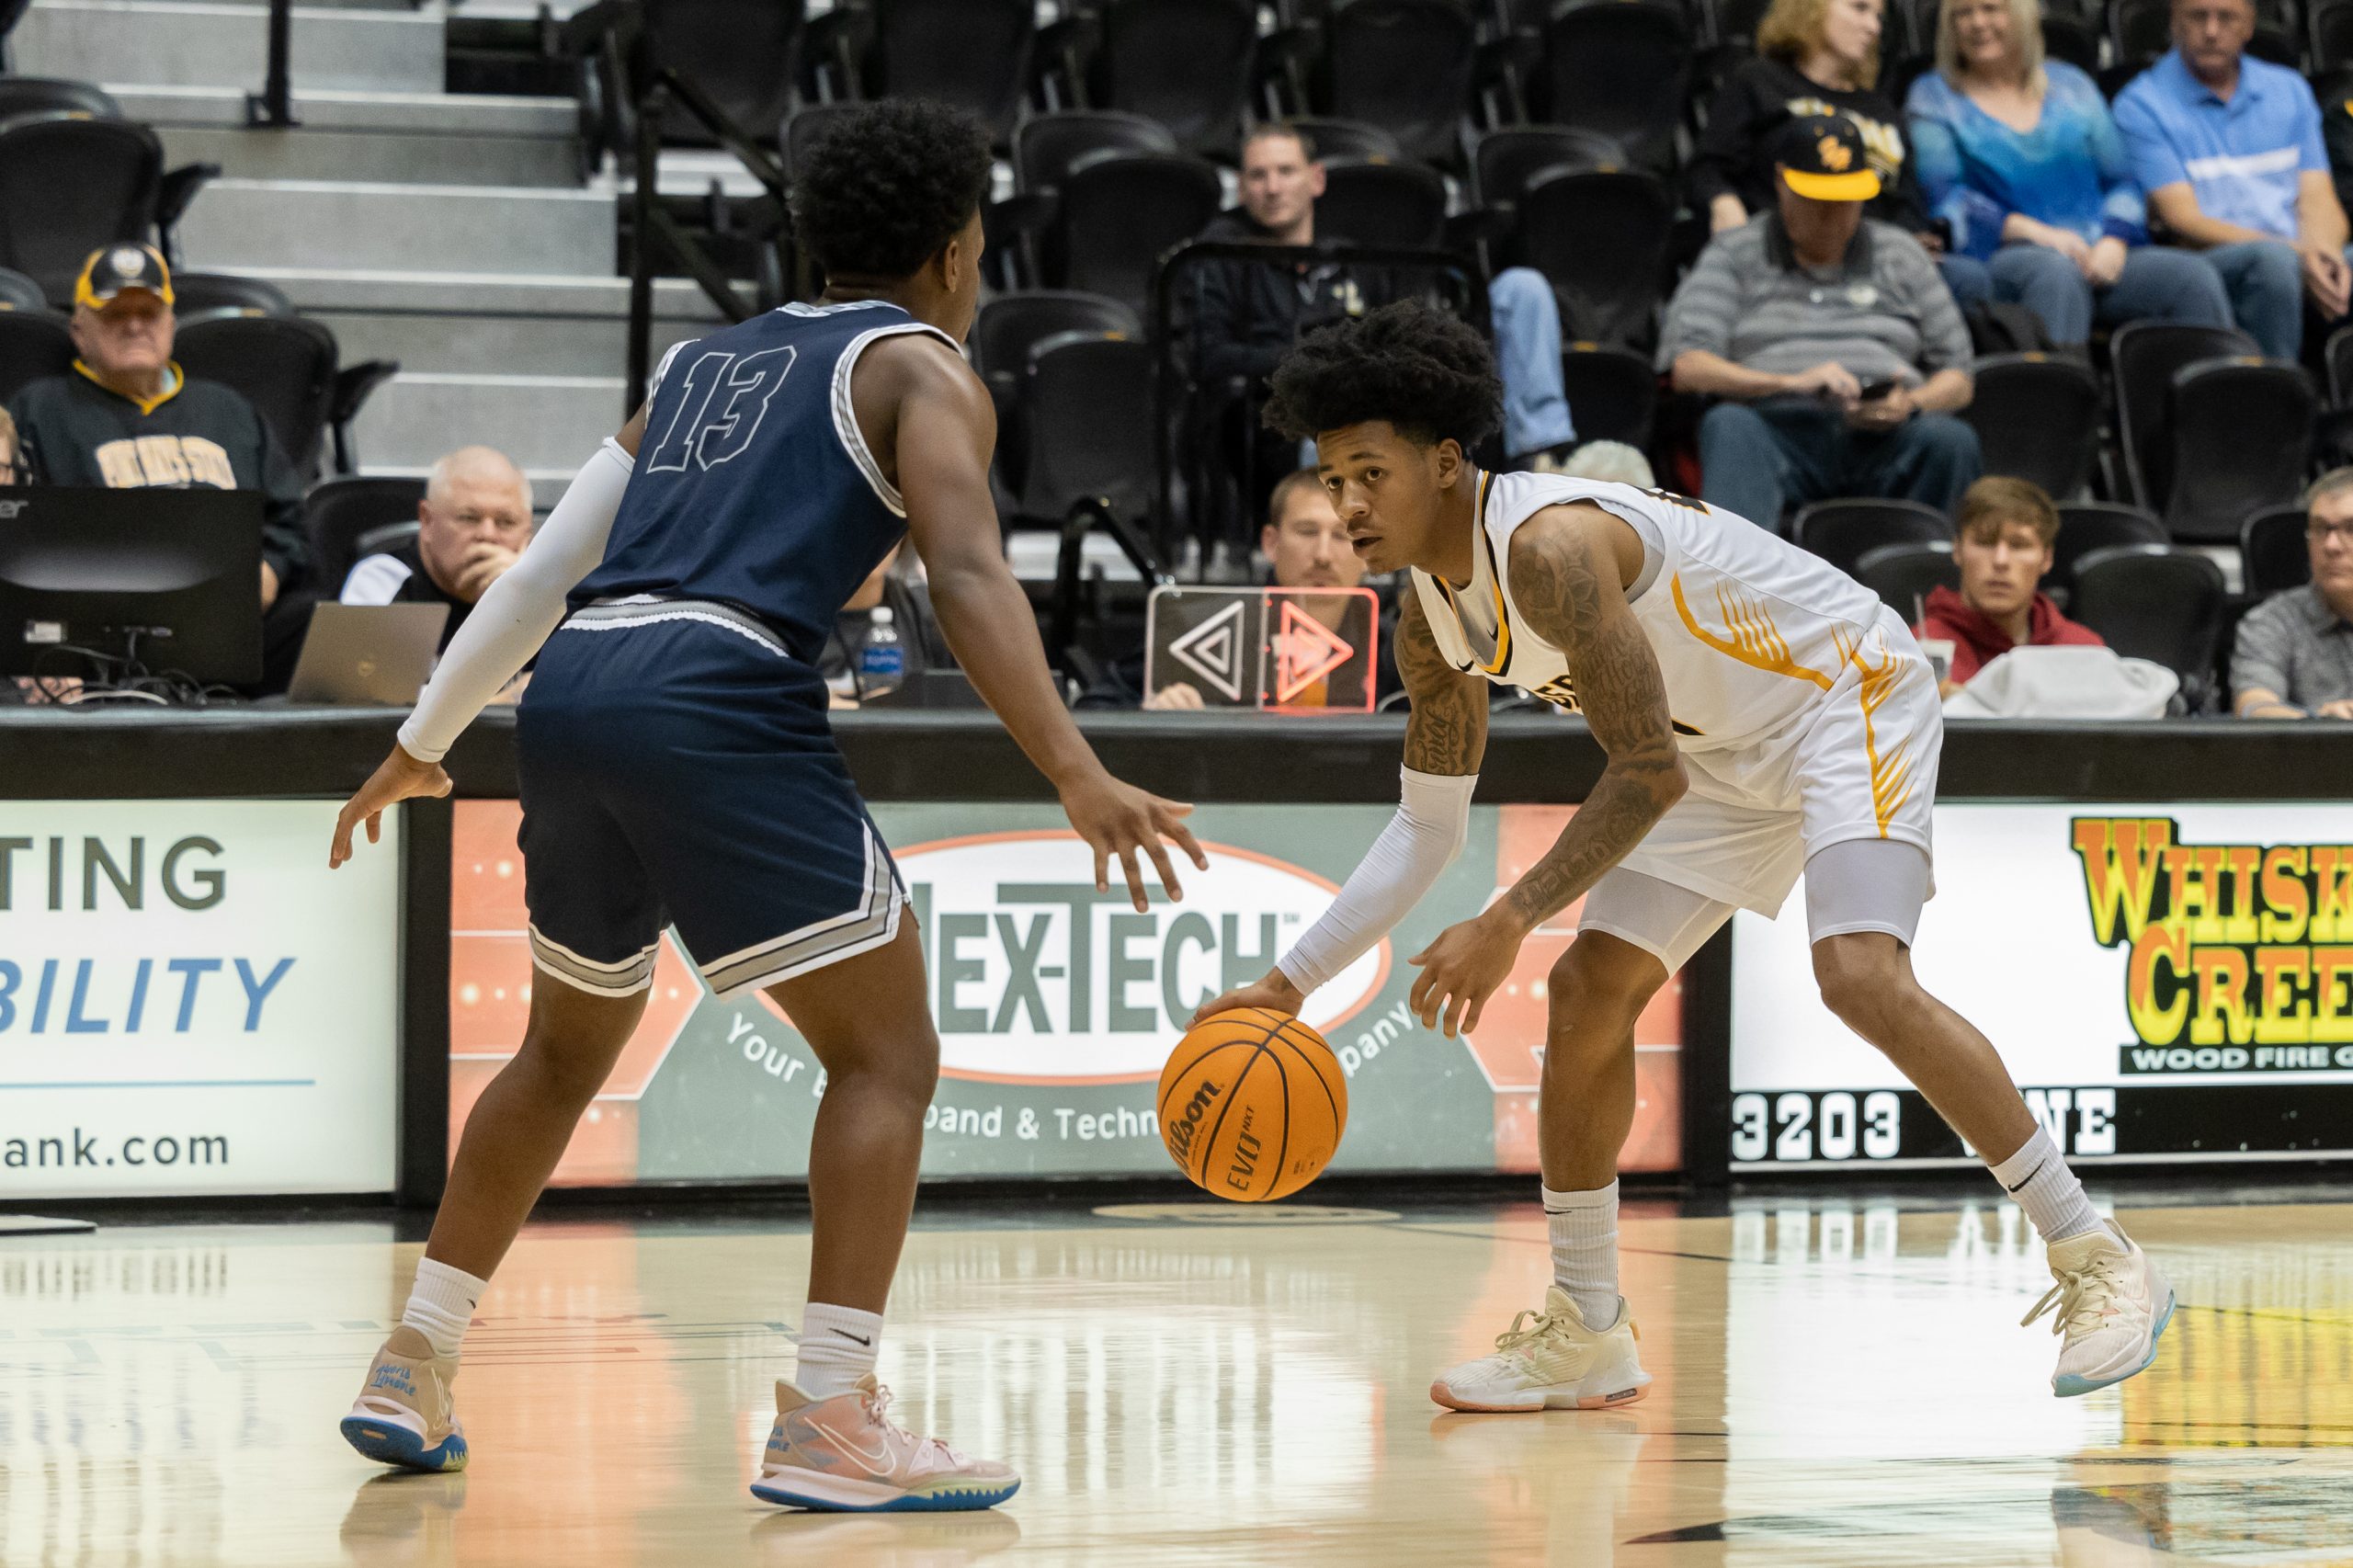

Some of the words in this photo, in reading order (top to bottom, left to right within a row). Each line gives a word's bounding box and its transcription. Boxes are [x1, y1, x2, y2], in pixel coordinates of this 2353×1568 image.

[646, 345, 797, 473] 13
[0, 835, 226, 911] TING
[726, 1011, 805, 1082] Your
[1016, 1107, 1040, 1140] &
[1052, 1105, 1162, 1141] Techn
[1338, 1000, 1414, 1078] pany
[2131, 1048, 2249, 1071] WOOD
[2255, 1046, 2330, 1069] FIRE
[5, 1128, 230, 1167] ank.com
[1733, 1091, 1901, 1161] 3203
